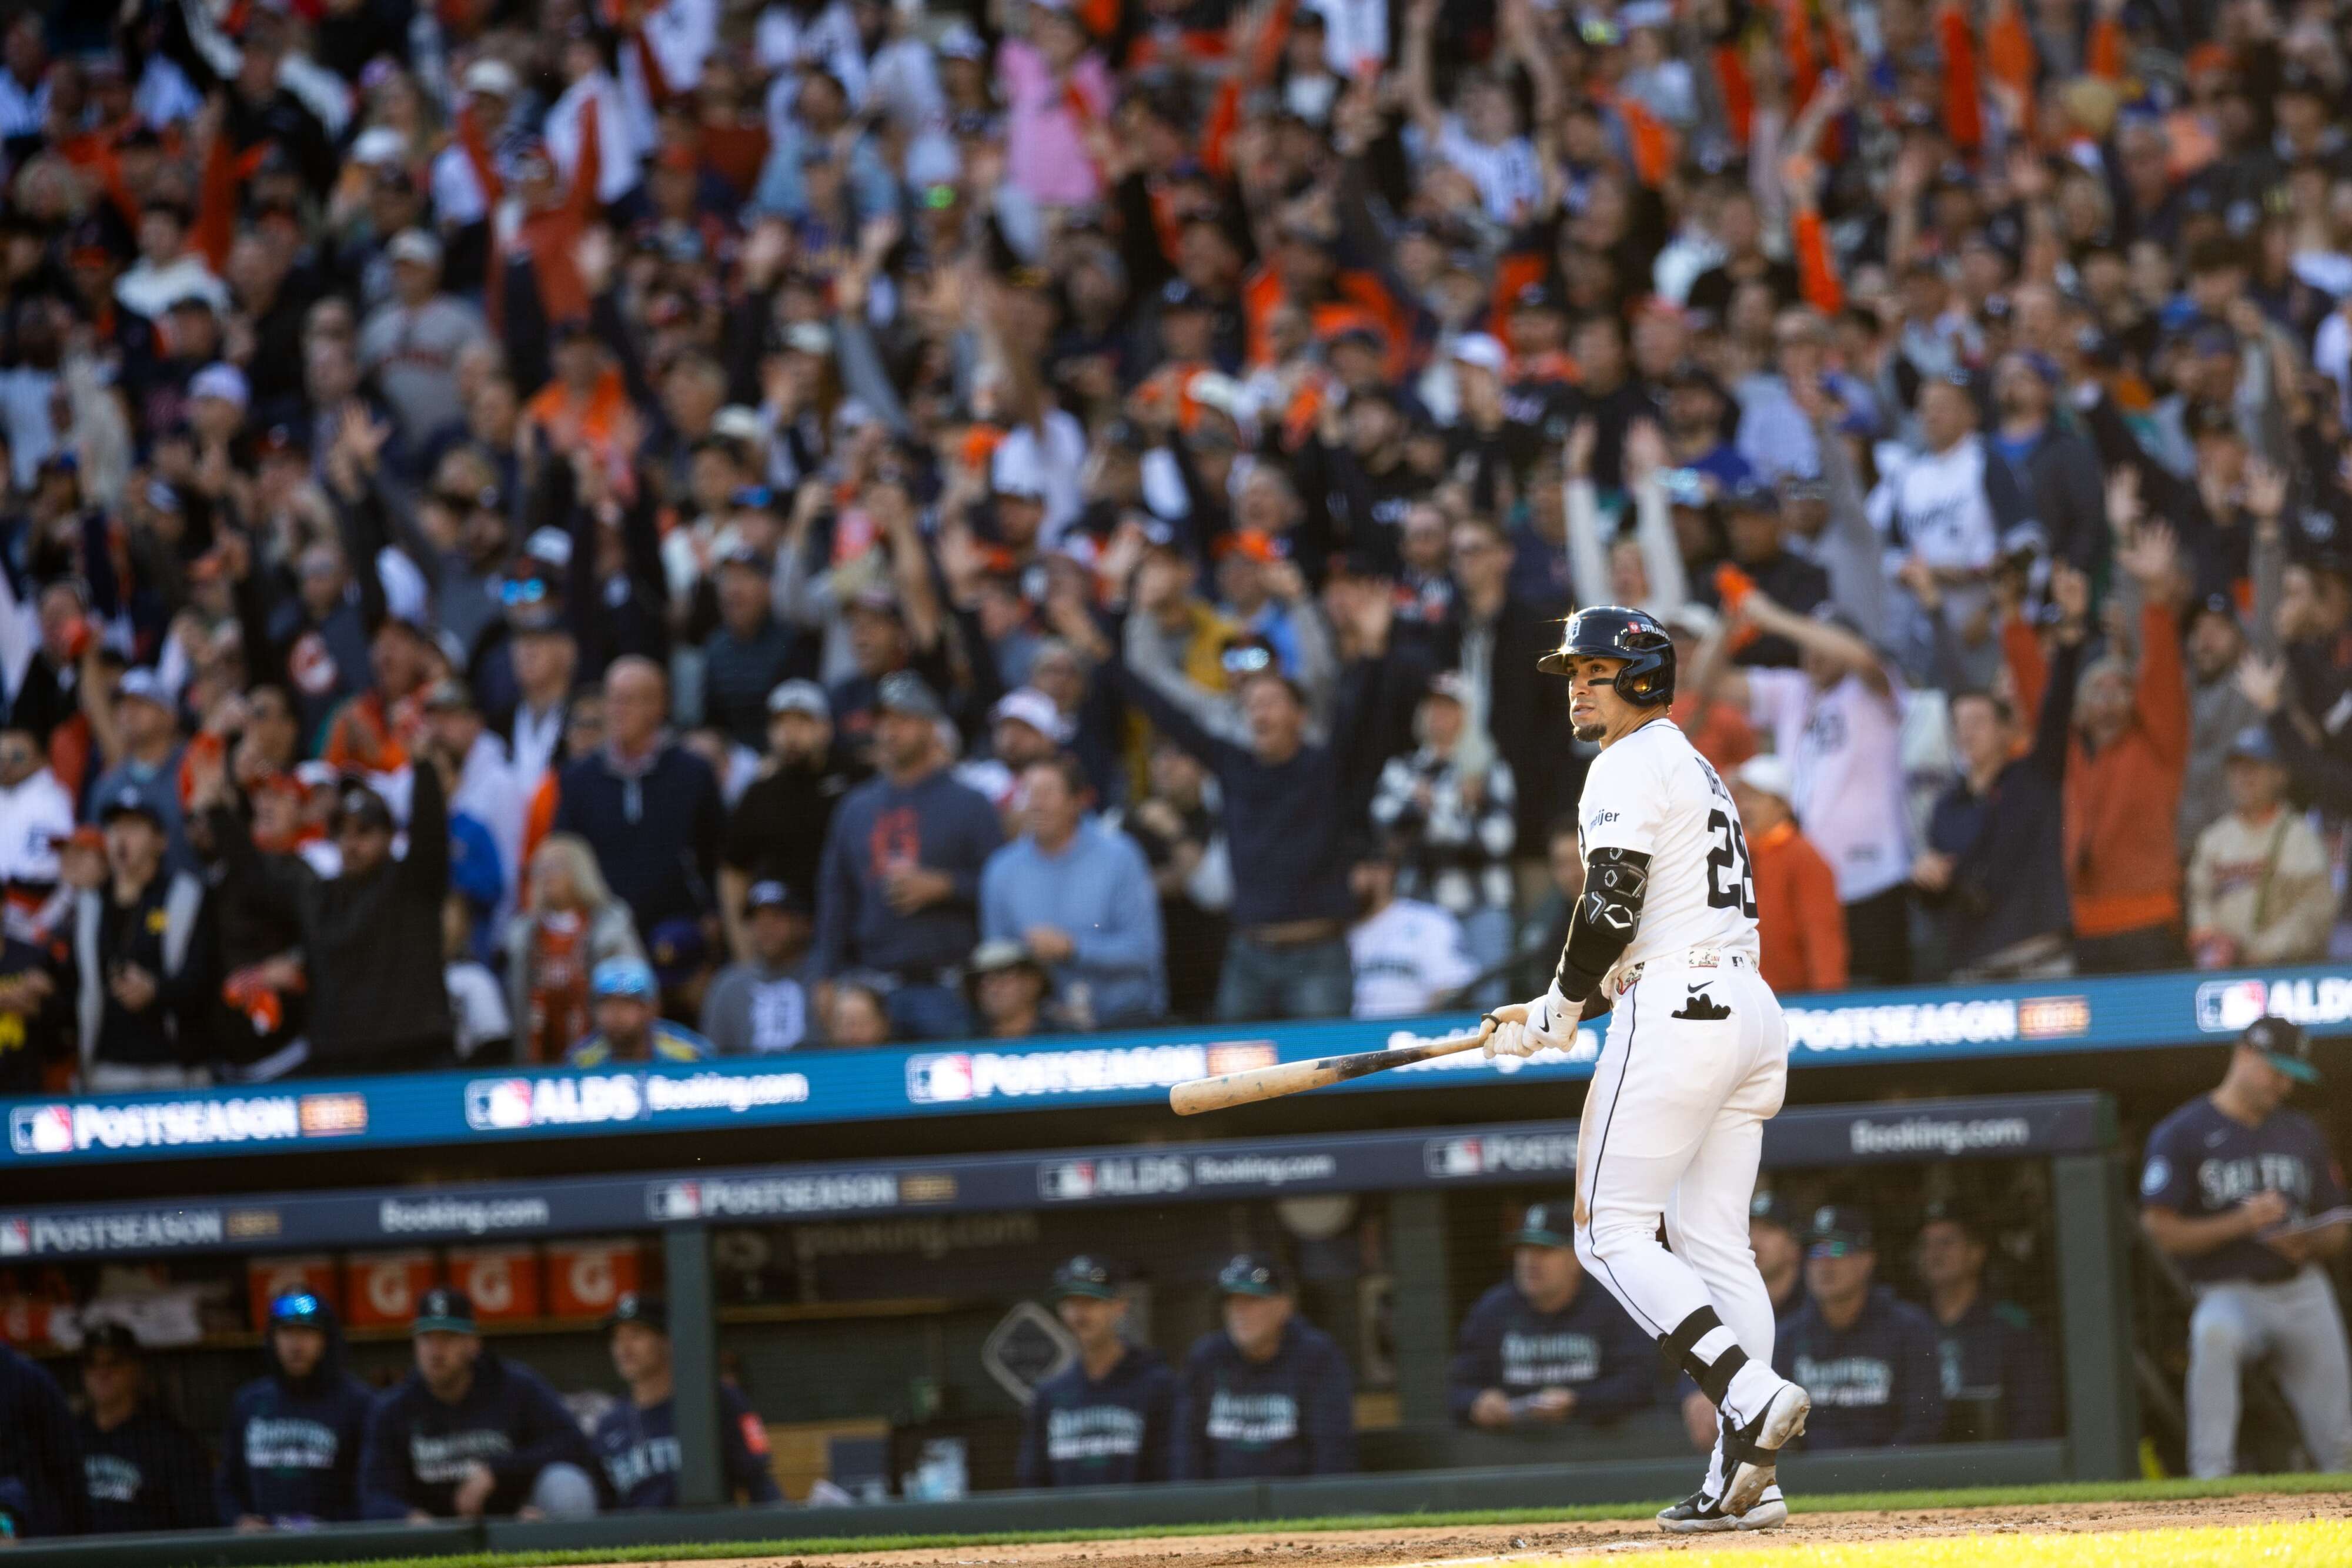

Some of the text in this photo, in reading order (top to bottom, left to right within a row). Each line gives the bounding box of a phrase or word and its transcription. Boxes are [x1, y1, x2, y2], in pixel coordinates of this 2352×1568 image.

[1706, 808, 1759, 918] 28
[2268, 977, 2352, 1024] ALD
[1785, 999, 2017, 1052] POSTSEASON
[973, 1044, 1205, 1097] POSTSEASON
[74, 1096, 299, 1149] POSTSEASON
[532, 1074, 639, 1124] ALDS
[1850, 1115, 2030, 1156] Booking.com
[701, 1174, 897, 1217] POSTSEASON
[1098, 1155, 1189, 1195] ALDS
[33, 1209, 223, 1253] POSTSEASON
[379, 1196, 550, 1235] Booking.com
